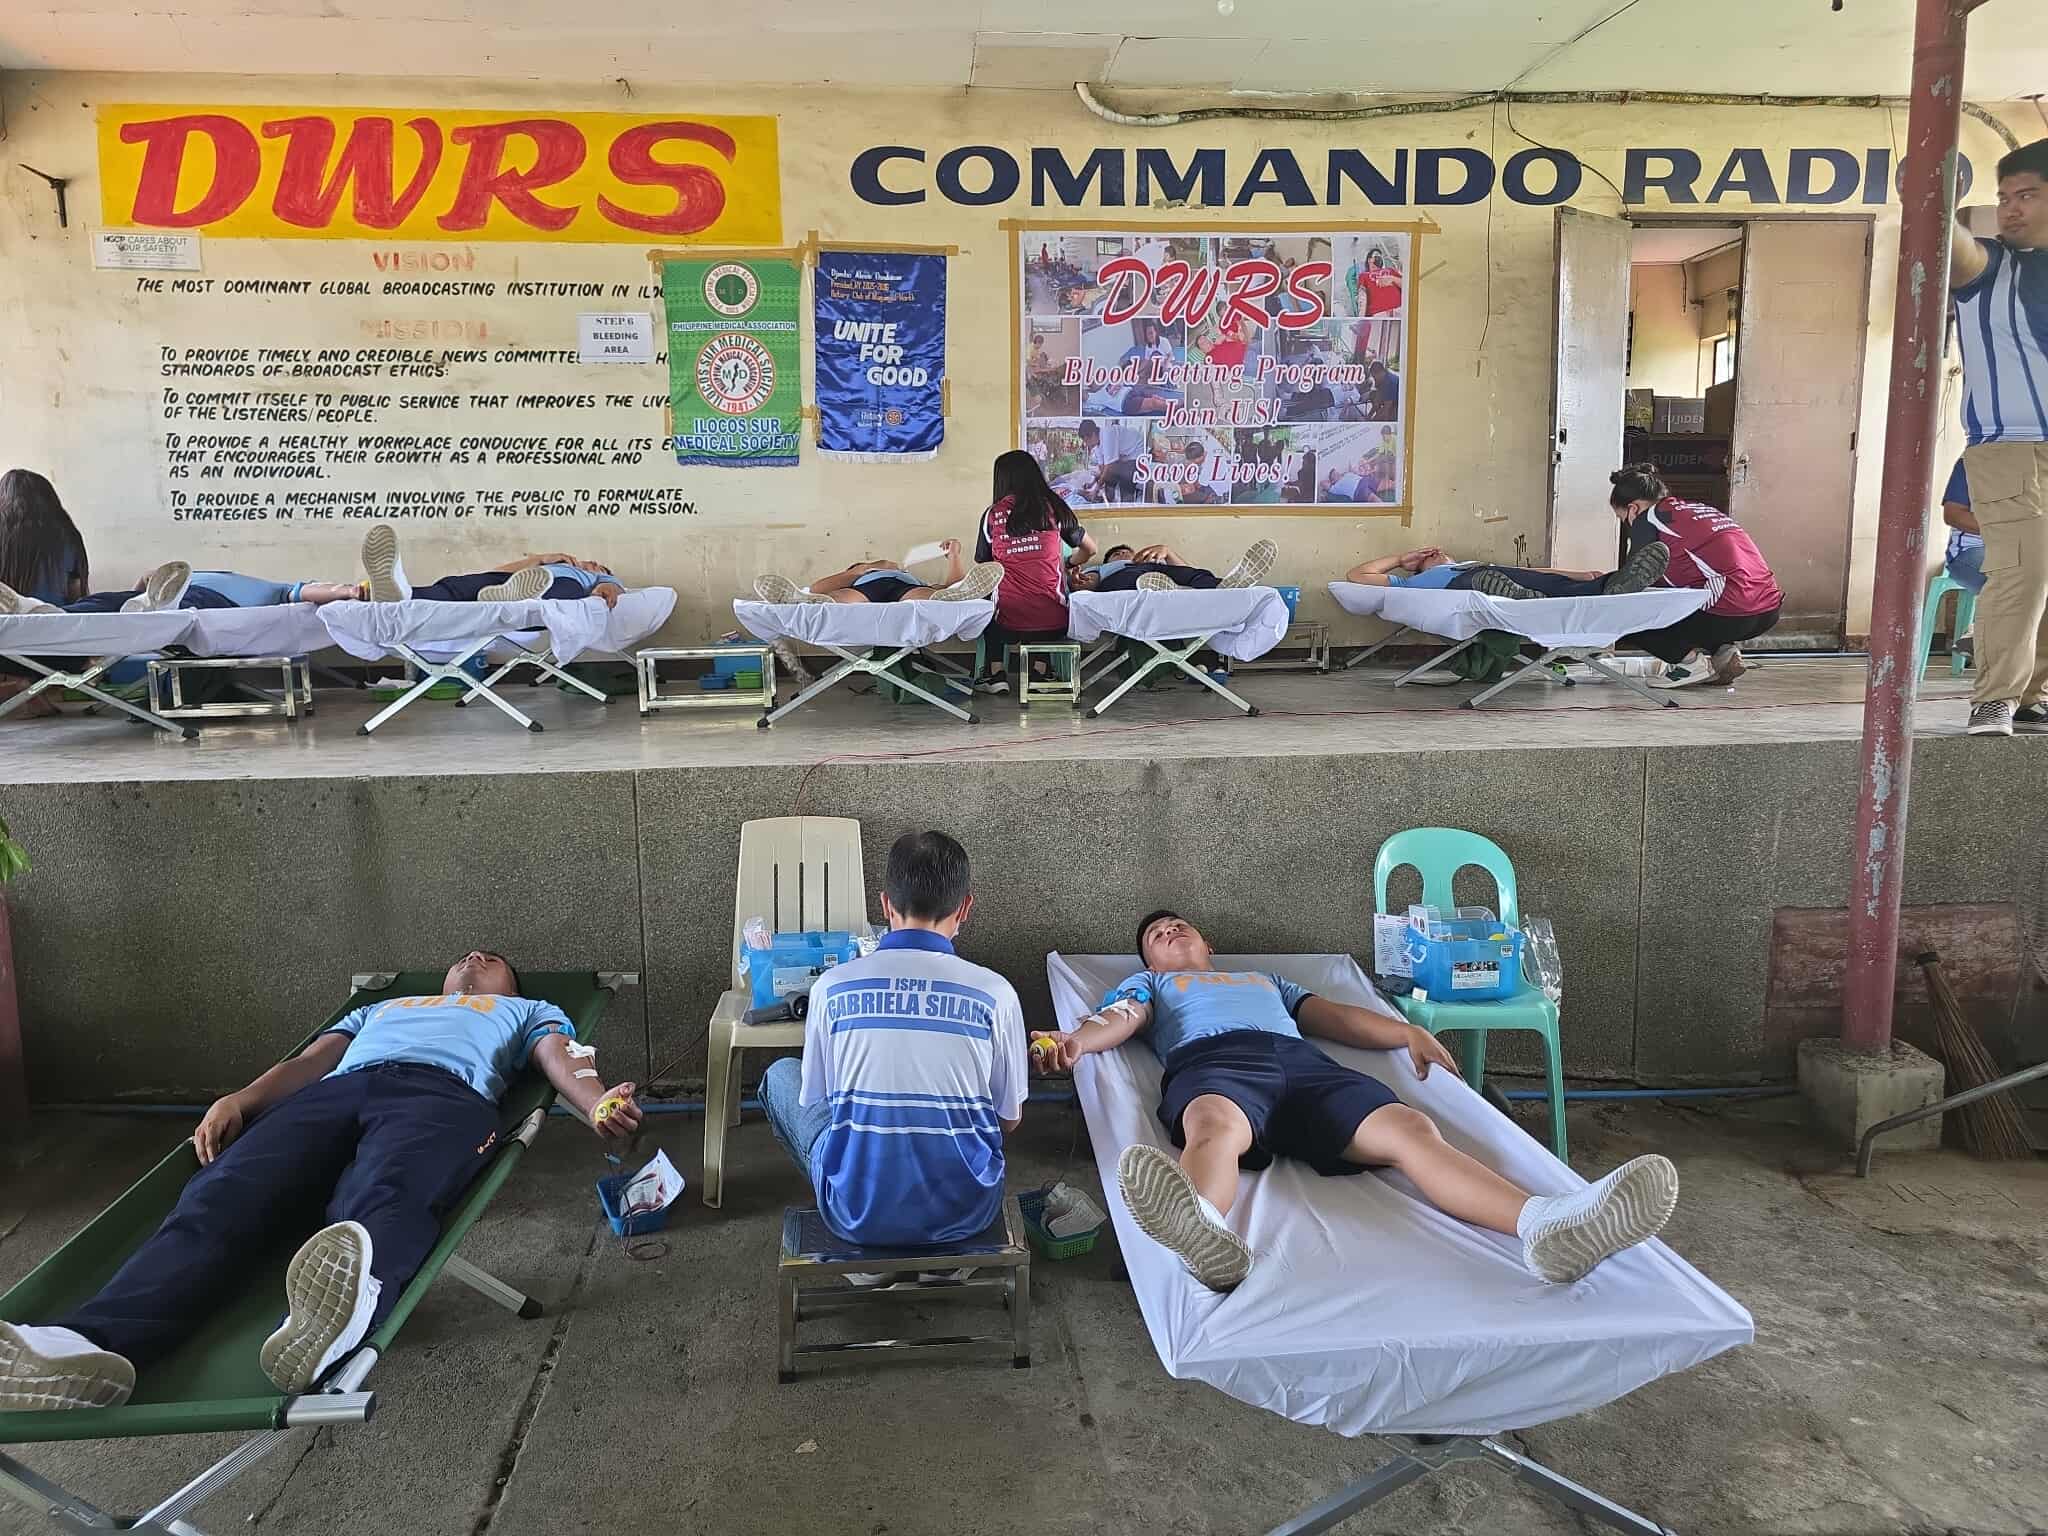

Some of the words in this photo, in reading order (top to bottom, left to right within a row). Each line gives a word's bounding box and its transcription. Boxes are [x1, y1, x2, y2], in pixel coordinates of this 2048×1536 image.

[119, 115, 737, 234] DWRS
[849, 146, 1582, 206] COMMANDO
[158, 237, 188, 245] ABOUT
[373, 252, 475, 272] VISION
[136, 277, 165, 293] THE
[171, 279, 215, 294] MOST
[223, 279, 312, 294] DOMINANT
[319, 281, 371, 296] GLOBAL
[382, 281, 496, 297] BROADCASTING
[506, 281, 605, 297] INSTITUTION
[611, 284, 630, 298] IN
[1098, 258, 1332, 330] DWRS
[595, 317, 625, 325] STEP
[673, 322, 713, 330] PHILIPPINE
[715, 322, 745, 330] MEDICAL
[748, 322, 796, 330] ASSOCIATION
[593, 332, 638, 340] BLEEDING
[833, 320, 898, 344] UNITE
[161, 346, 177, 362] TO
[184, 348, 250, 362] PROVIDE
[258, 348, 312, 363] TIMELY
[317, 349, 351, 363] AND
[355, 348, 434, 364] CREDIBLE
[441, 350, 487, 363] NEWS
[700, 345, 718, 366] SUR
[718, 335, 764, 357] MEDICAL
[859, 344, 904, 365] FOR
[160, 363, 256, 377] STANDARDS
[263, 365, 283, 377] OF
[292, 365, 382, 377] BROADCAST
[389, 365, 449, 377] ETHICS:
[866, 367, 928, 387] GOOD
[1062, 356, 1140, 385] Blood
[1148, 356, 1244, 391] Letting
[1256, 355, 1366, 392] Program
[699, 369, 724, 406] ILOCOS
[752, 358, 772, 405] SOCIETY
[163, 387, 179, 405] TO
[185, 392, 252, 407] COMMIT
[255, 392, 309, 407] ITSELF
[314, 393, 332, 408] TO
[339, 393, 392, 409] PUBLIC
[399, 395, 461, 409] SERVICE
[469, 395, 510, 409] THAT
[515, 394, 596, 409] IMPROVES
[605, 394, 634, 408] THE
[164, 406, 184, 419] OF
[188, 407, 217, 420] THE
[1158, 399, 1217, 430] Join
[1231, 399, 1282, 426] US!
[695, 419, 746, 434] ILOCOS
[751, 419, 780, 434] SUR
[165, 432, 181, 449] TO
[186, 435, 252, 449] PROVIDE
[258, 436, 269, 449] A
[278, 435, 349, 450] HEALTHY
[358, 435, 453, 450] WORKPLACE
[459, 436, 548, 451] CONDUCIVE
[554, 437, 585, 451] FOR
[591, 438, 619, 451] ALL
[627, 437, 653, 451] ITS
[673, 435, 737, 451] MEDICAL
[741, 435, 799, 450] SOCIETY
[168, 450, 207, 463] THAT
[213, 449, 316, 464] ENCOURAGES
[325, 450, 368, 464] THEIR
[374, 450, 443, 464] GROWTH
[449, 451, 470, 464] AS
[476, 451, 487, 465] A
[495, 451, 606, 466] PROFESSIONAL
[611, 451, 643, 465] AND
[169, 464, 190, 479] AS
[200, 465, 225, 479] AN
[233, 465, 331, 479] INDIVIDUAL.
[1133, 454, 1199, 483] Save
[1211, 453, 1293, 483] Lives!
[170, 490, 187, 508] TO
[196, 492, 260, 507] PROVIDE
[264, 492, 275, 506] A
[285, 491, 377, 506] MECHANISM
[386, 491, 466, 505] INVOLVING
[475, 490, 504, 503] THE
[511, 489, 565, 503] PUBLIC
[573, 489, 591, 503] TO
[597, 488, 684, 502] FORMULATE
[173, 507, 268, 521] STRATEGIES
[275, 507, 294, 520] IN
[303, 506, 334, 519] THE
[342, 505, 449, 519] REALIZATION
[454, 505, 475, 518] OF
[483, 504, 518, 517] THIS
[525, 503, 577, 517] VISION
[587, 502, 621, 516] AND
[629, 502, 698, 515] MISSION.
[1012, 536, 1039, 545] BLOOD
[895, 978, 927, 992] ISPH
[827, 992, 920, 1020] GABRIELA
